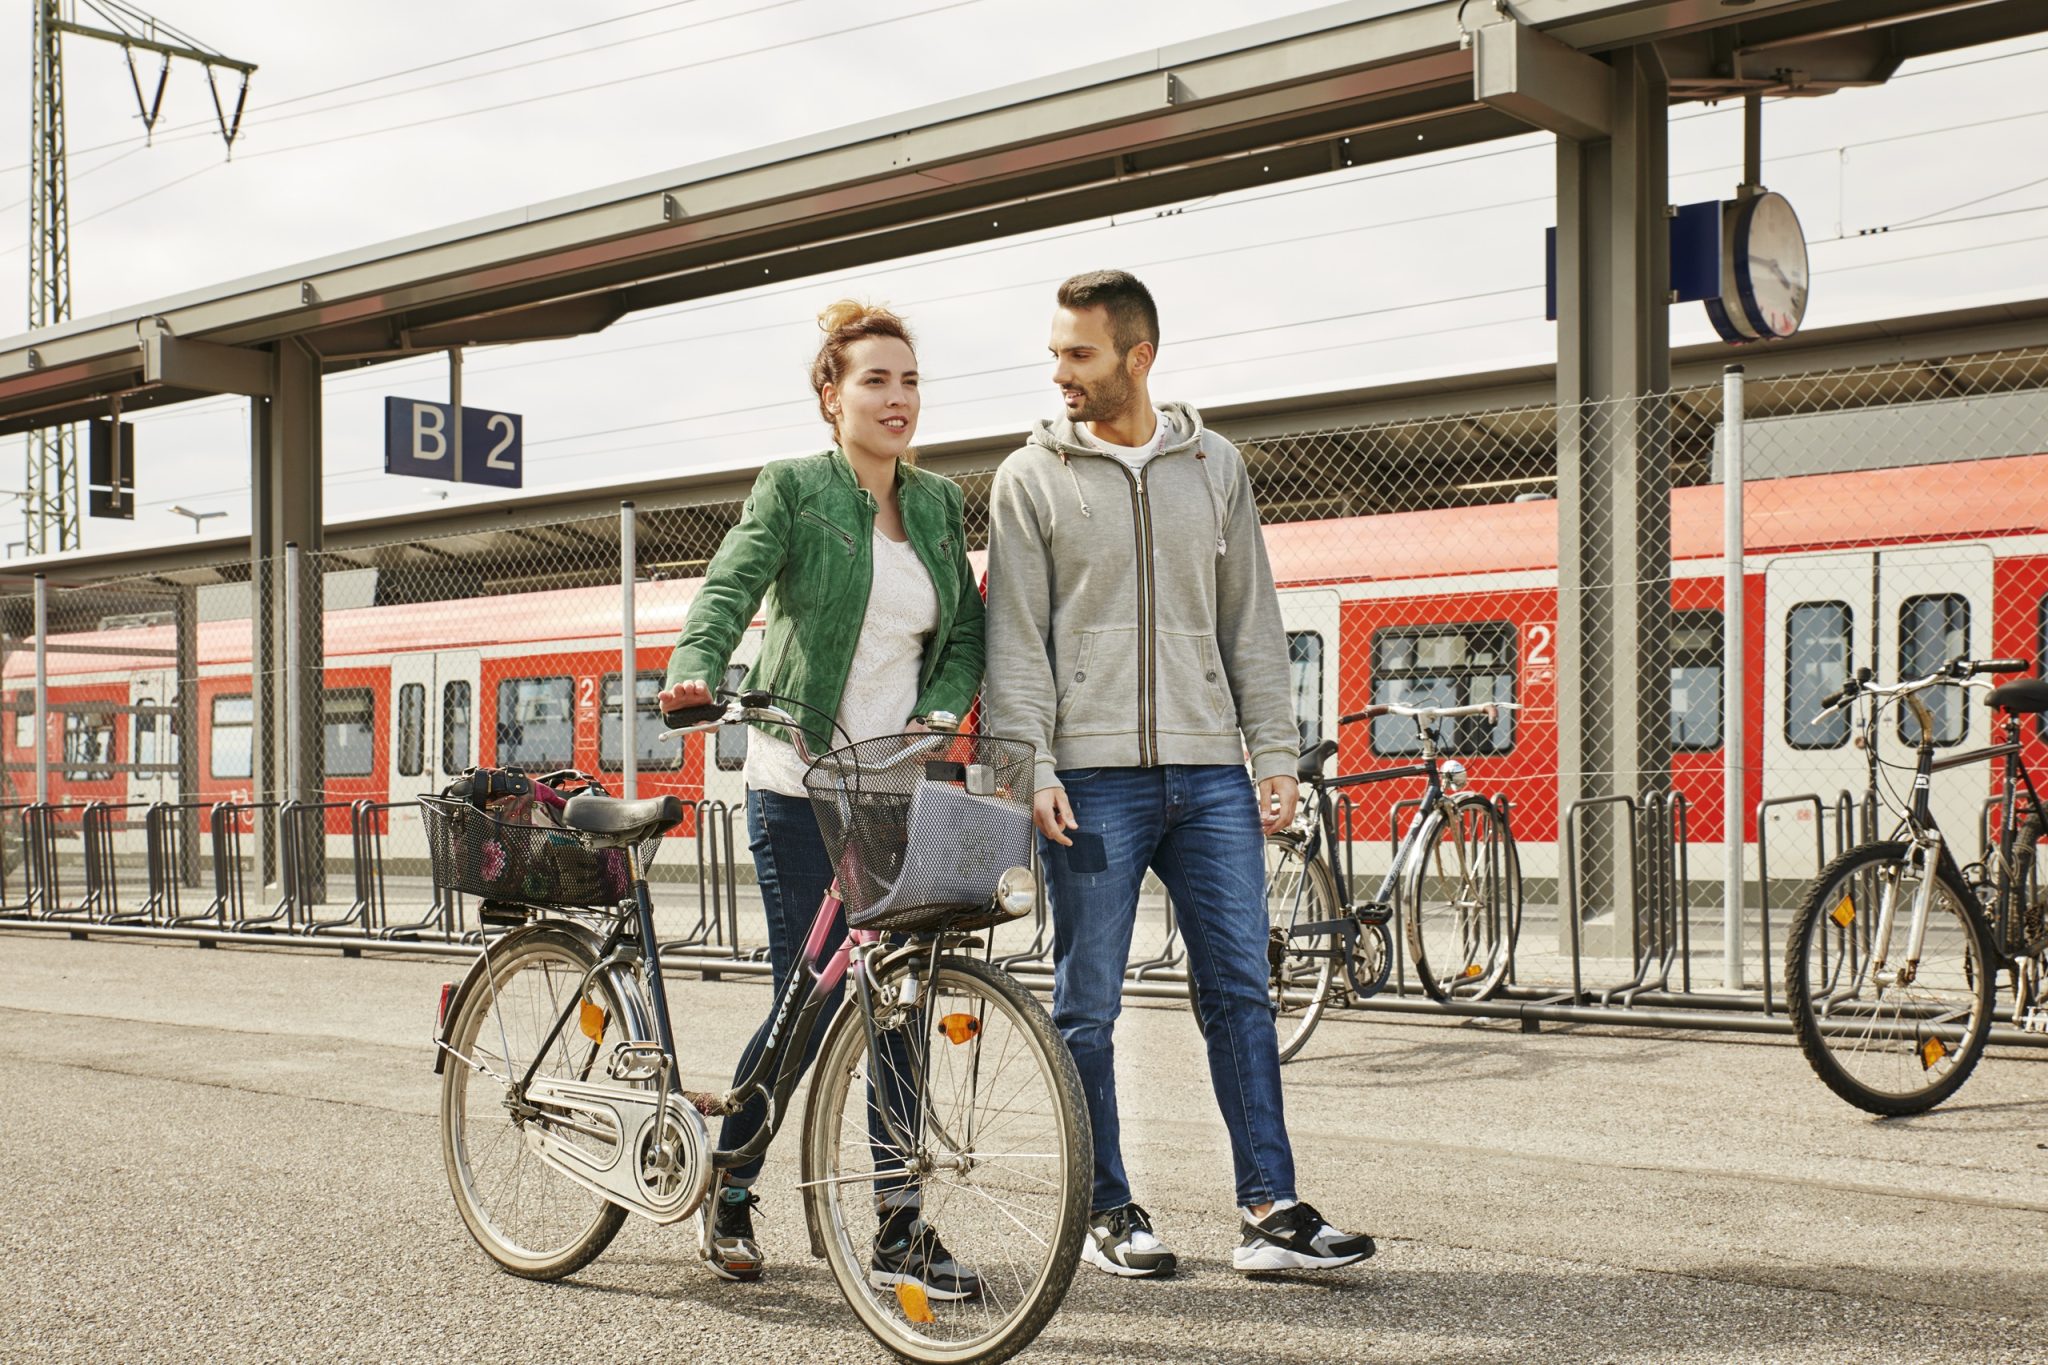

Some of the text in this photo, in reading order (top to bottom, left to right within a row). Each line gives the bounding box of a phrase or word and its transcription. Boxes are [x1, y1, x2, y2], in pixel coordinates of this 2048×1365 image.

[412, 402, 516, 471] B 2
[1527, 625, 1551, 665] 2
[580, 678, 594, 707] 2
